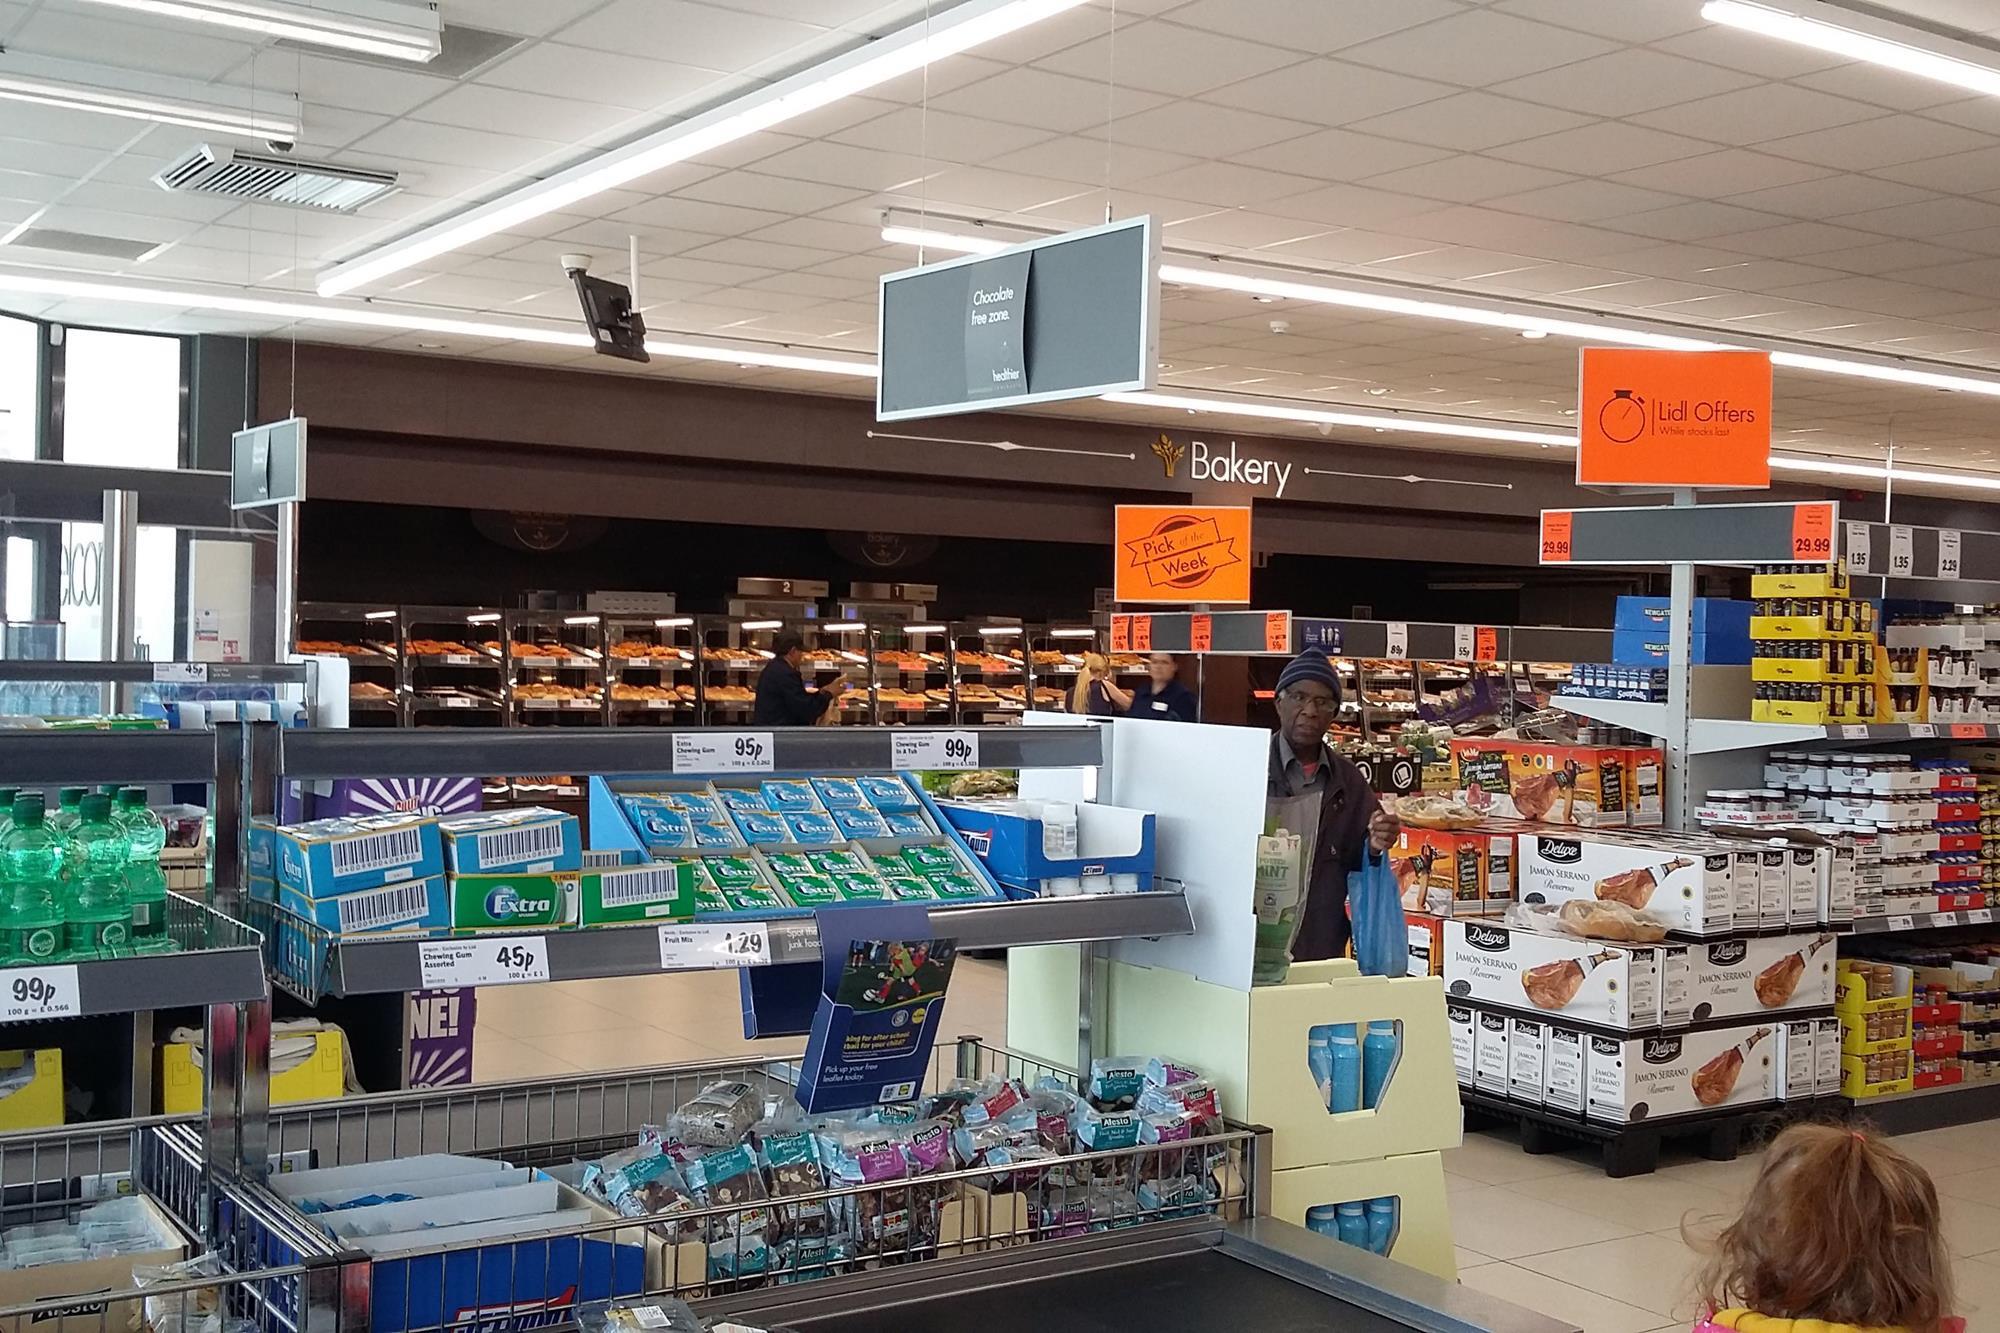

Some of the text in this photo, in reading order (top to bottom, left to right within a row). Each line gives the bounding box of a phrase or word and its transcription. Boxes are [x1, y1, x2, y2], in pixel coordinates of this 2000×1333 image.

[973, 286, 1014, 306] Chocolate
[971, 309, 1010, 326] free zone.
[992, 367, 1020, 382] healthier
[1659, 400, 1755, 423] Lidl Offers
[1660, 426, 1730, 436] While stocks last
[1191, 441, 1292, 498] Bakery
[1143, 536, 1175, 558] Pick
[1543, 541, 1569, 554] 29.99
[1795, 538, 1830, 552] 29.99
[1161, 552, 1209, 577] Week
[1851, 552, 1866, 566] 1.35
[1893, 556, 1909, 569] 1.35
[783, 582, 790, 593] 2
[185, 663, 203, 676] 45p
[735, 737, 763, 760] 95p
[945, 738, 972, 761] 99p
[649, 820, 690, 833] Extra
[1540, 838, 1578, 861] Deluxe
[1529, 865, 1590, 882] JAMÓN SERRANO
[494, 895, 550, 913] Extra
[725, 932, 762, 954] 1.29
[1468, 926, 1506, 946] Deluxe
[424, 953, 454, 961] Chewing
[496, 945, 534, 971] 45p
[1711, 942, 1745, 960] Deluxe
[1455, 951, 1518, 971] JAMÓN SERRANO
[1723, 970, 1752, 982] SERRANO
[12, 977, 56, 1006] 99p
[8, 1008, 22, 1016] 100
[1646, 1039, 1679, 1057] Deluxe
[825, 1065, 838, 1073] Pick
[1108, 1070, 1133, 1079] Alesto
[1659, 1067, 1688, 1081] SERRANO
[1103, 1118, 1129, 1126] Alesto
[916, 1127, 940, 1143] Alesto
